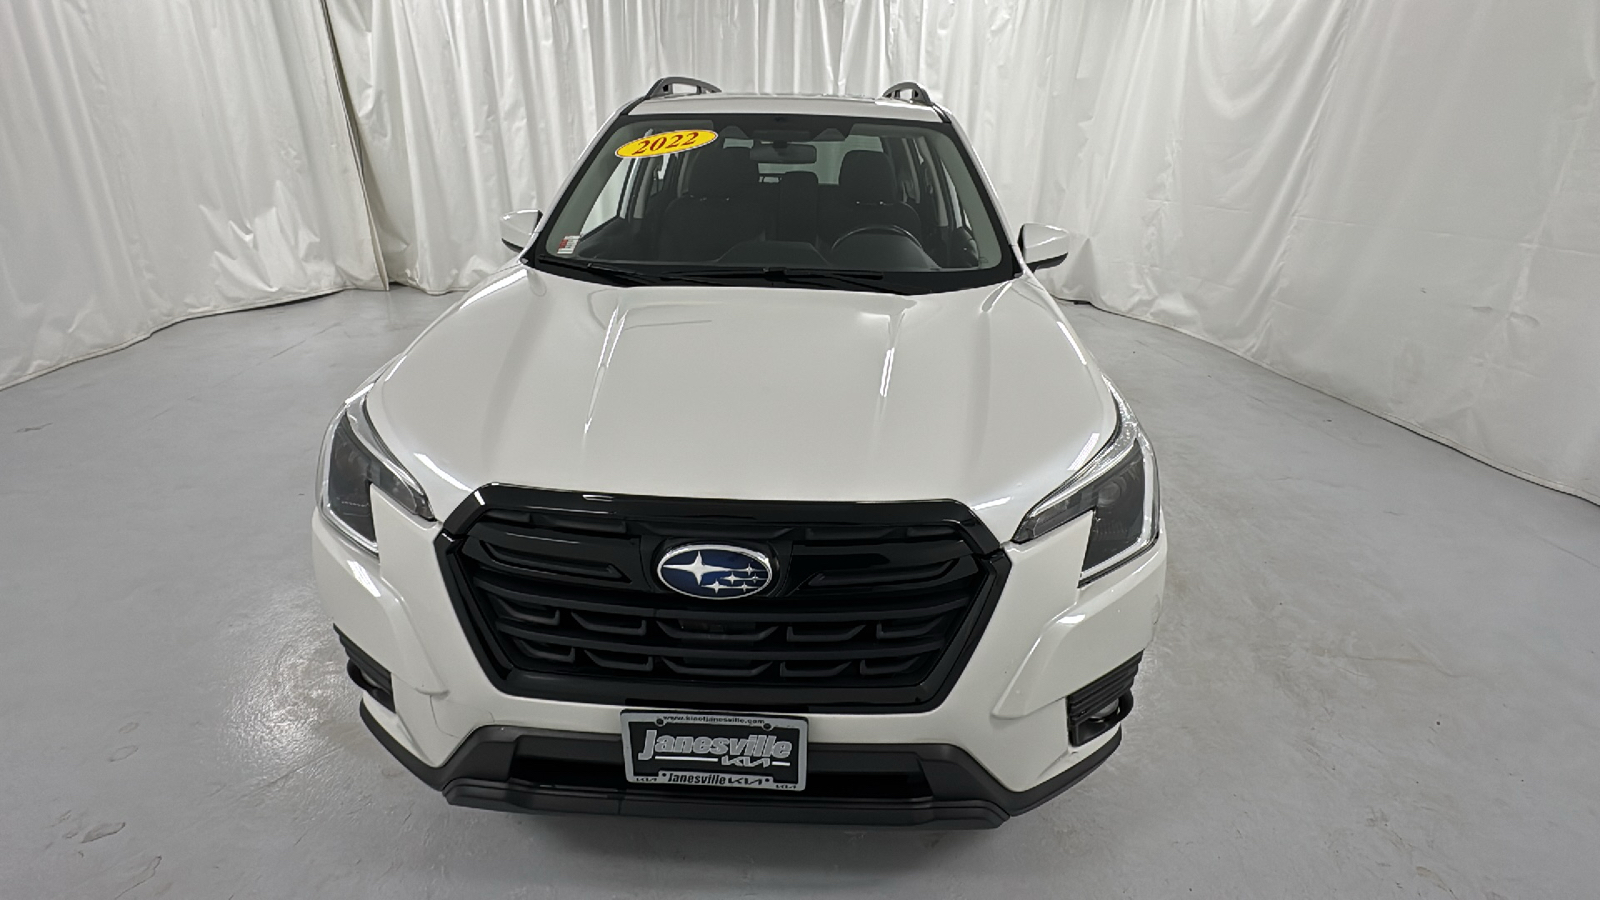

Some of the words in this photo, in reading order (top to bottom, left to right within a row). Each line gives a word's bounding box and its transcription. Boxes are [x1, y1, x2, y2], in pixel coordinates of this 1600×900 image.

[631, 132, 699, 155] 2022
[637, 729, 793, 761] Janesville
[667, 772, 726, 785] Janesville
